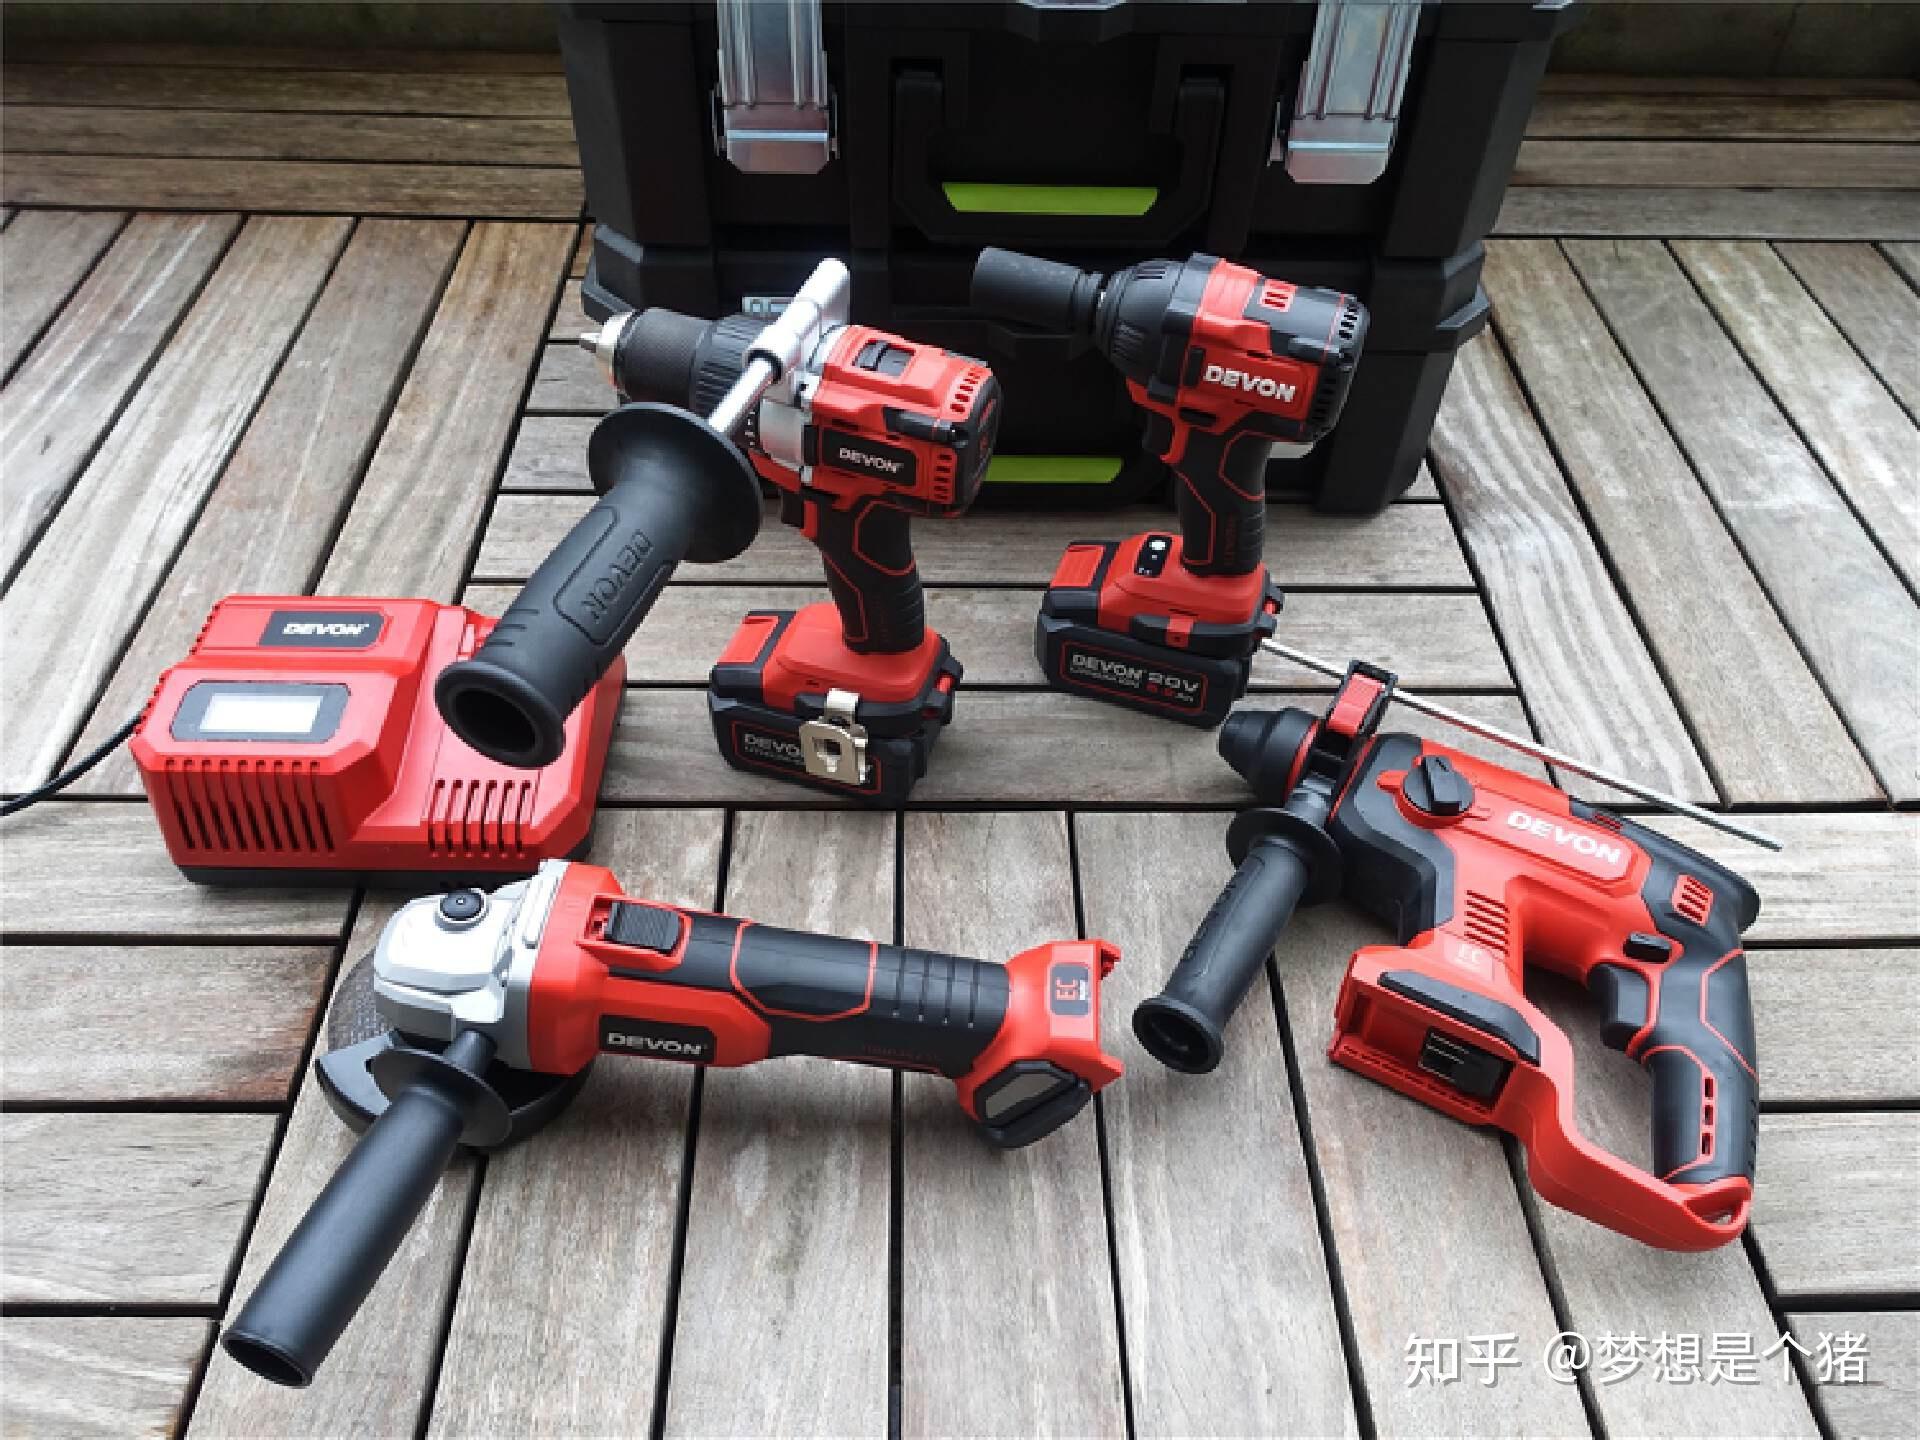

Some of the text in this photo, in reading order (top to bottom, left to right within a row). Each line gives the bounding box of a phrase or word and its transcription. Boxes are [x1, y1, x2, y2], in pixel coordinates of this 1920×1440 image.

[1203, 364, 1296, 403] DEVON
[839, 447, 903, 474] DEVON
[283, 622, 369, 637] DEVON
[1072, 654, 1144, 684] DEVON
[744, 733, 803, 758] DEVO
[1507, 810, 1621, 864] DEVON
[1056, 977, 1077, 1001] EC
[608, 1032, 702, 1055] DEVON
